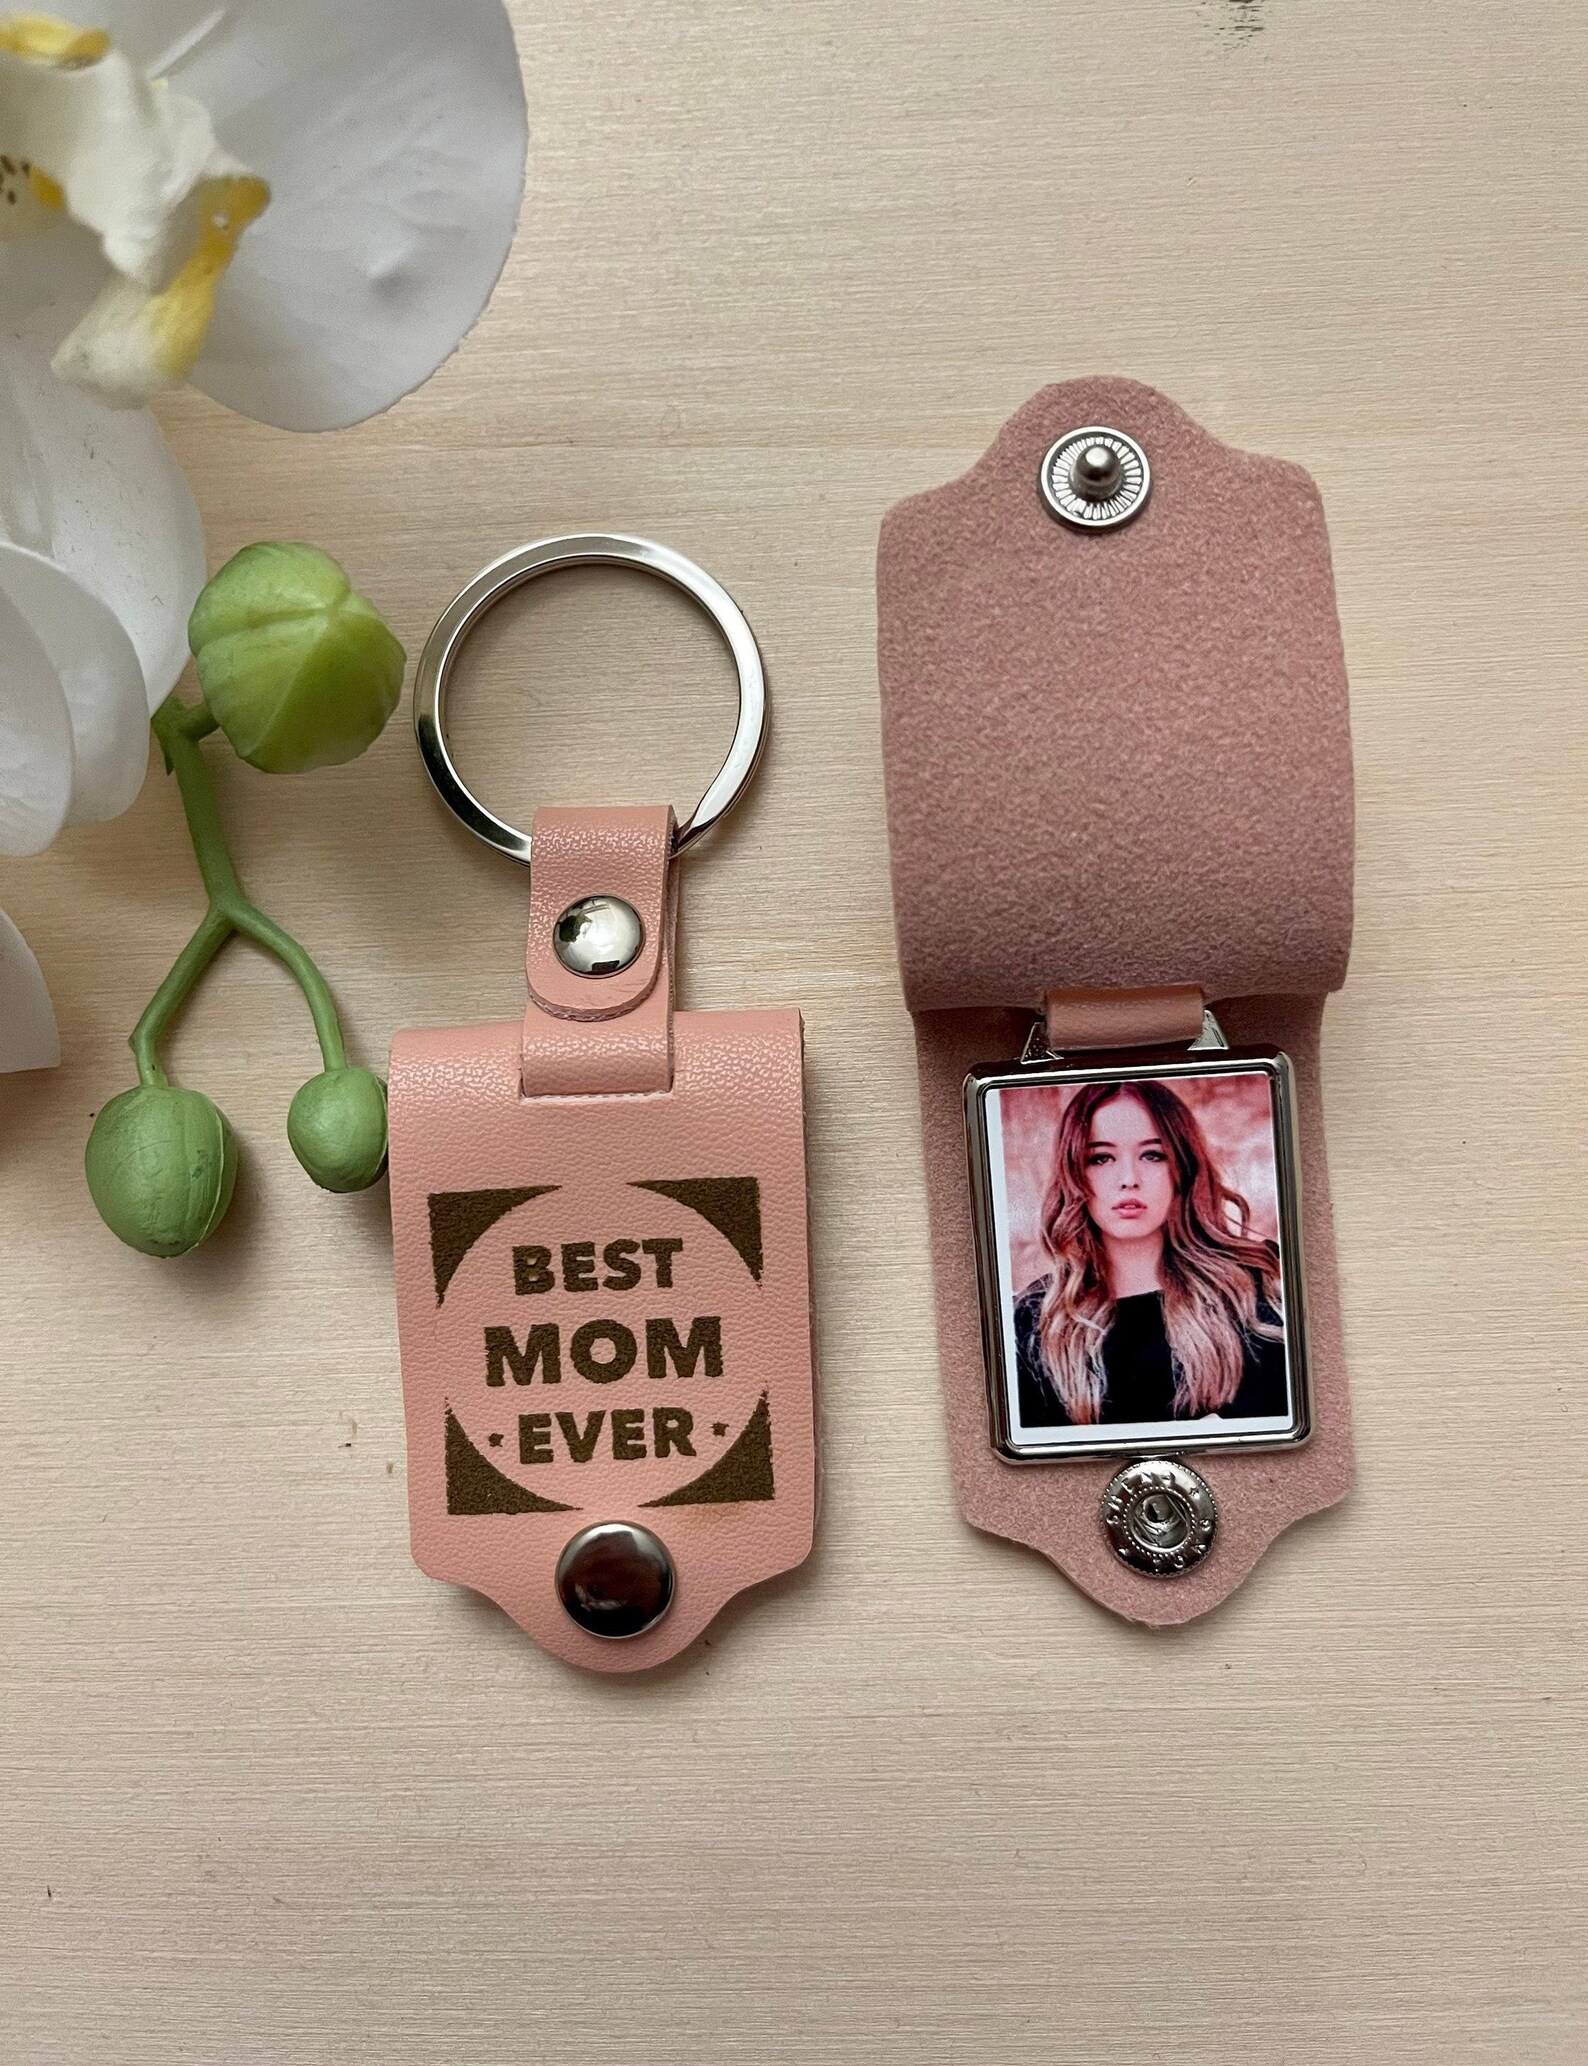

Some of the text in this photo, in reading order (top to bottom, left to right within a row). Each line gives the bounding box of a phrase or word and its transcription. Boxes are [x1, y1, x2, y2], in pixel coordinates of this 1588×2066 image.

[511, 1237, 684, 1296] BEST
[484, 1315, 724, 1387] MOM
[518, 1407, 697, 1465] EVER
